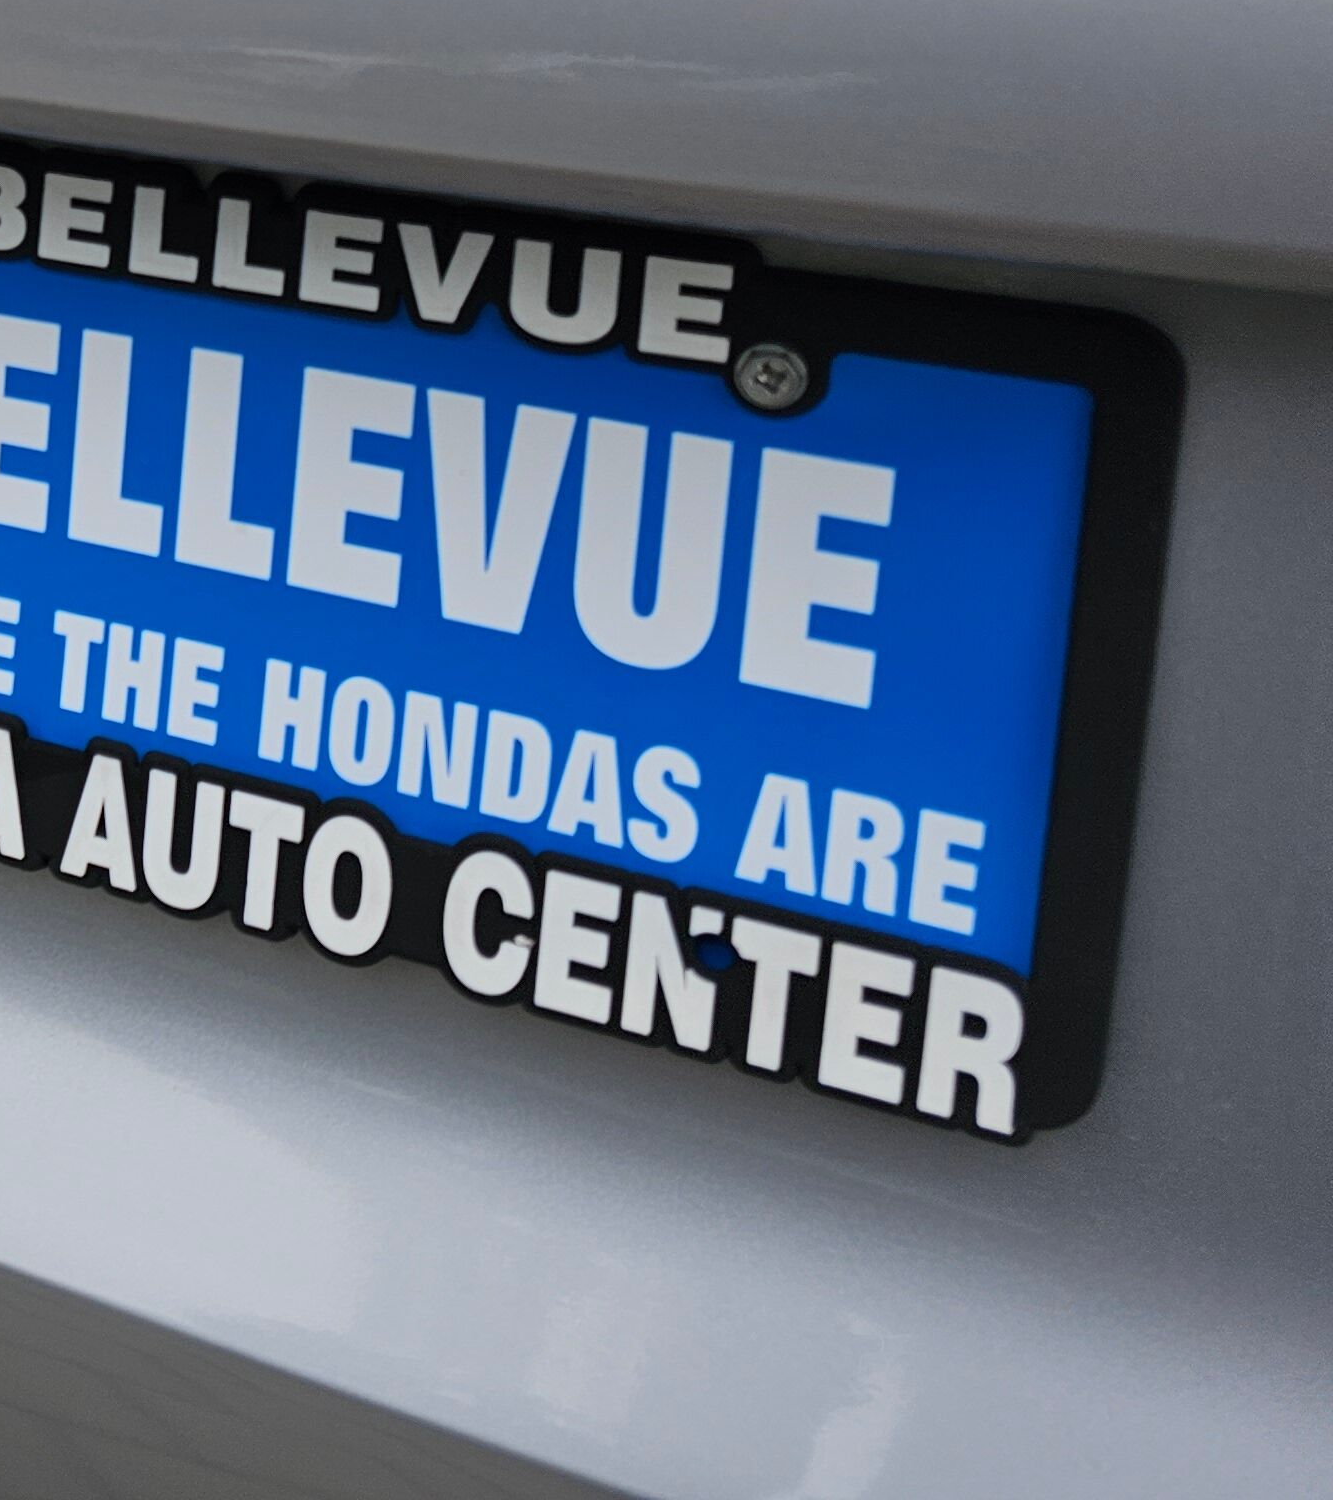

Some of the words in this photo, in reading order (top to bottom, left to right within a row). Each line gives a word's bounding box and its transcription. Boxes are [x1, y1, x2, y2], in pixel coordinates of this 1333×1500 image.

[52, 610, 226, 747] THE
[257, 657, 701, 863] HONDAS
[734, 772, 987, 937] ARE
[59, 751, 394, 958] AUTO
[441, 847, 1027, 1139] CENTER
